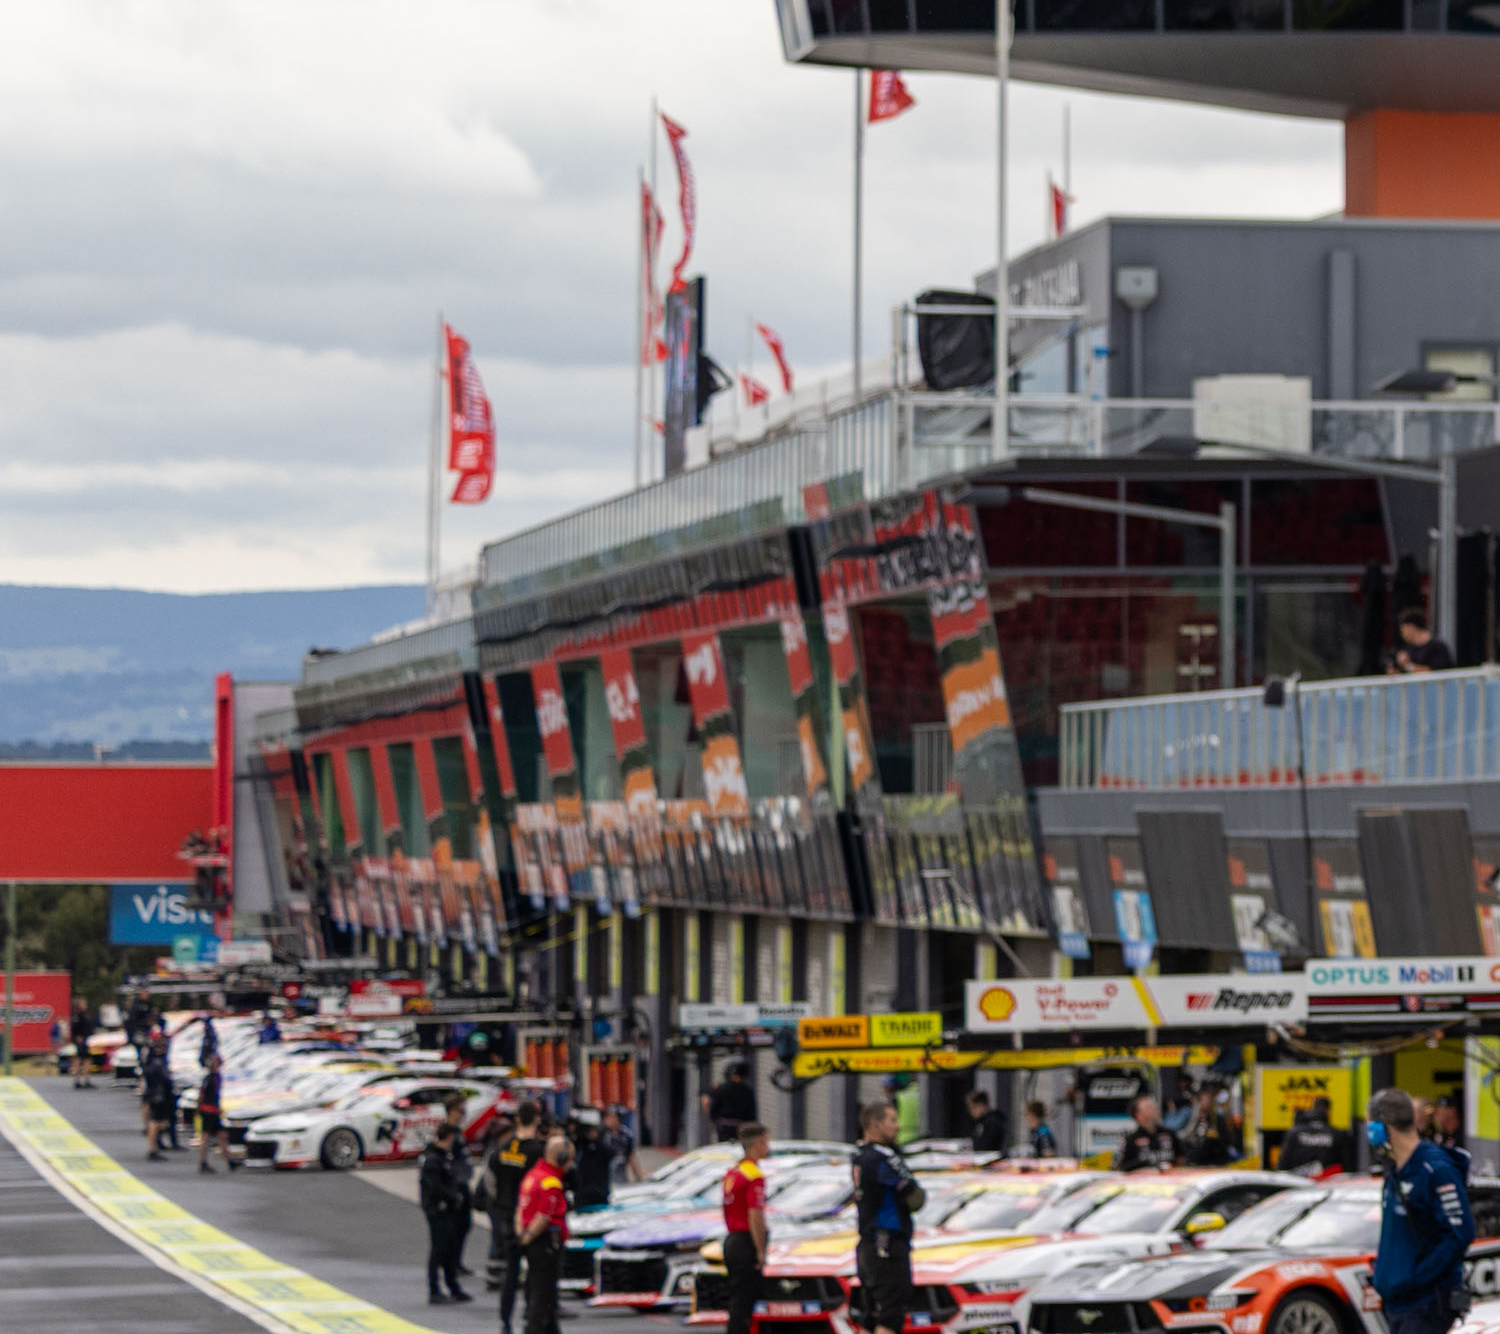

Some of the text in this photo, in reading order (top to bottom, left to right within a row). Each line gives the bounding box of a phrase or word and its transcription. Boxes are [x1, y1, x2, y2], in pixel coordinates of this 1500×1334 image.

[1312, 964, 1453, 986] OPTUS Mobil
[1212, 989, 1294, 1012] Repco
